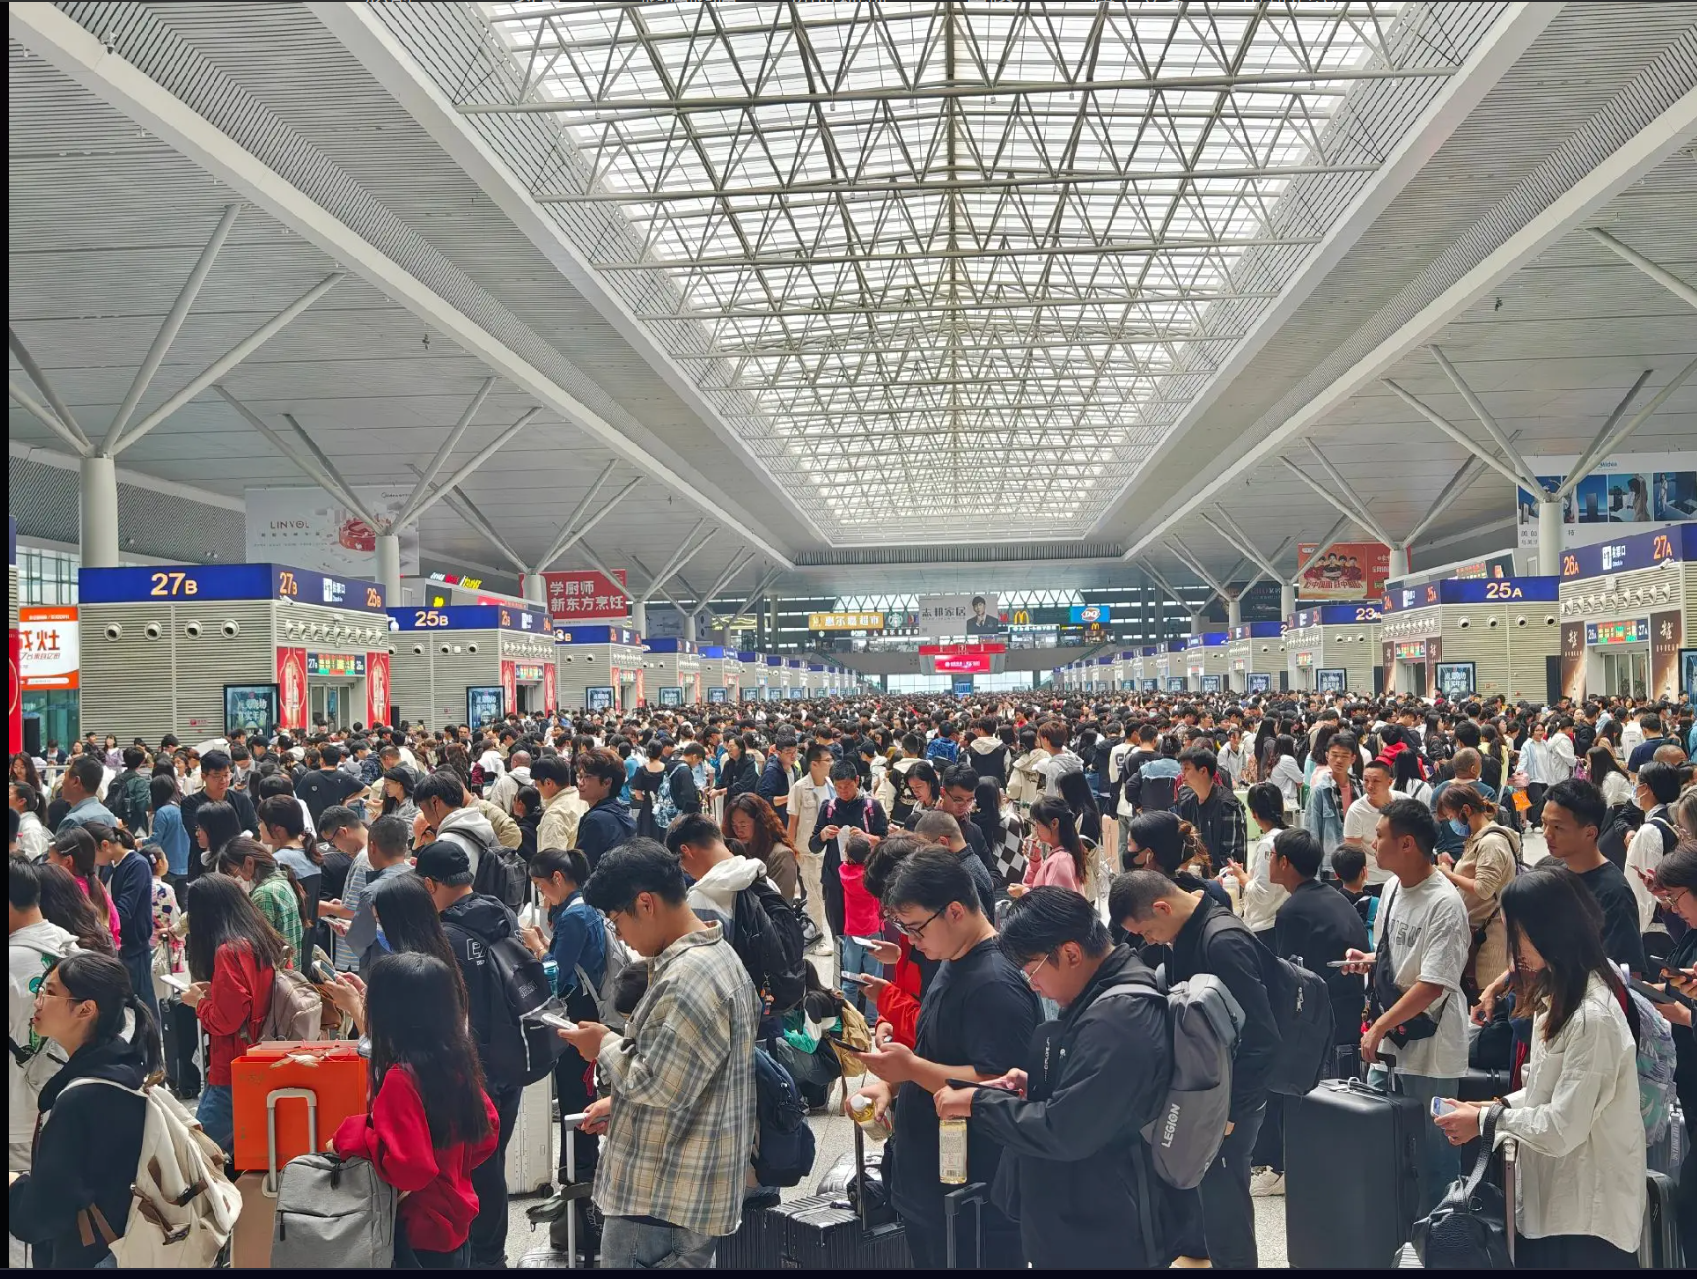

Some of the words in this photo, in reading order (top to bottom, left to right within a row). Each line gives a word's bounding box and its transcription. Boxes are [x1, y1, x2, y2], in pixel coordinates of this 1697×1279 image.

[1653, 535, 1673, 560] 27A
[1563, 554, 1580, 576] 26A
[150, 572, 199, 596] 27B
[279, 571, 298, 595] 27B
[550, 580, 595, 596] 学厨师
[1486, 582, 1523, 599] 25A
[367, 587, 382, 608] 26B
[550, 595, 624, 612] 新东方烹饪
[415, 610, 449, 627] 25B
[1161, 1103, 1181, 1148] LEGION
